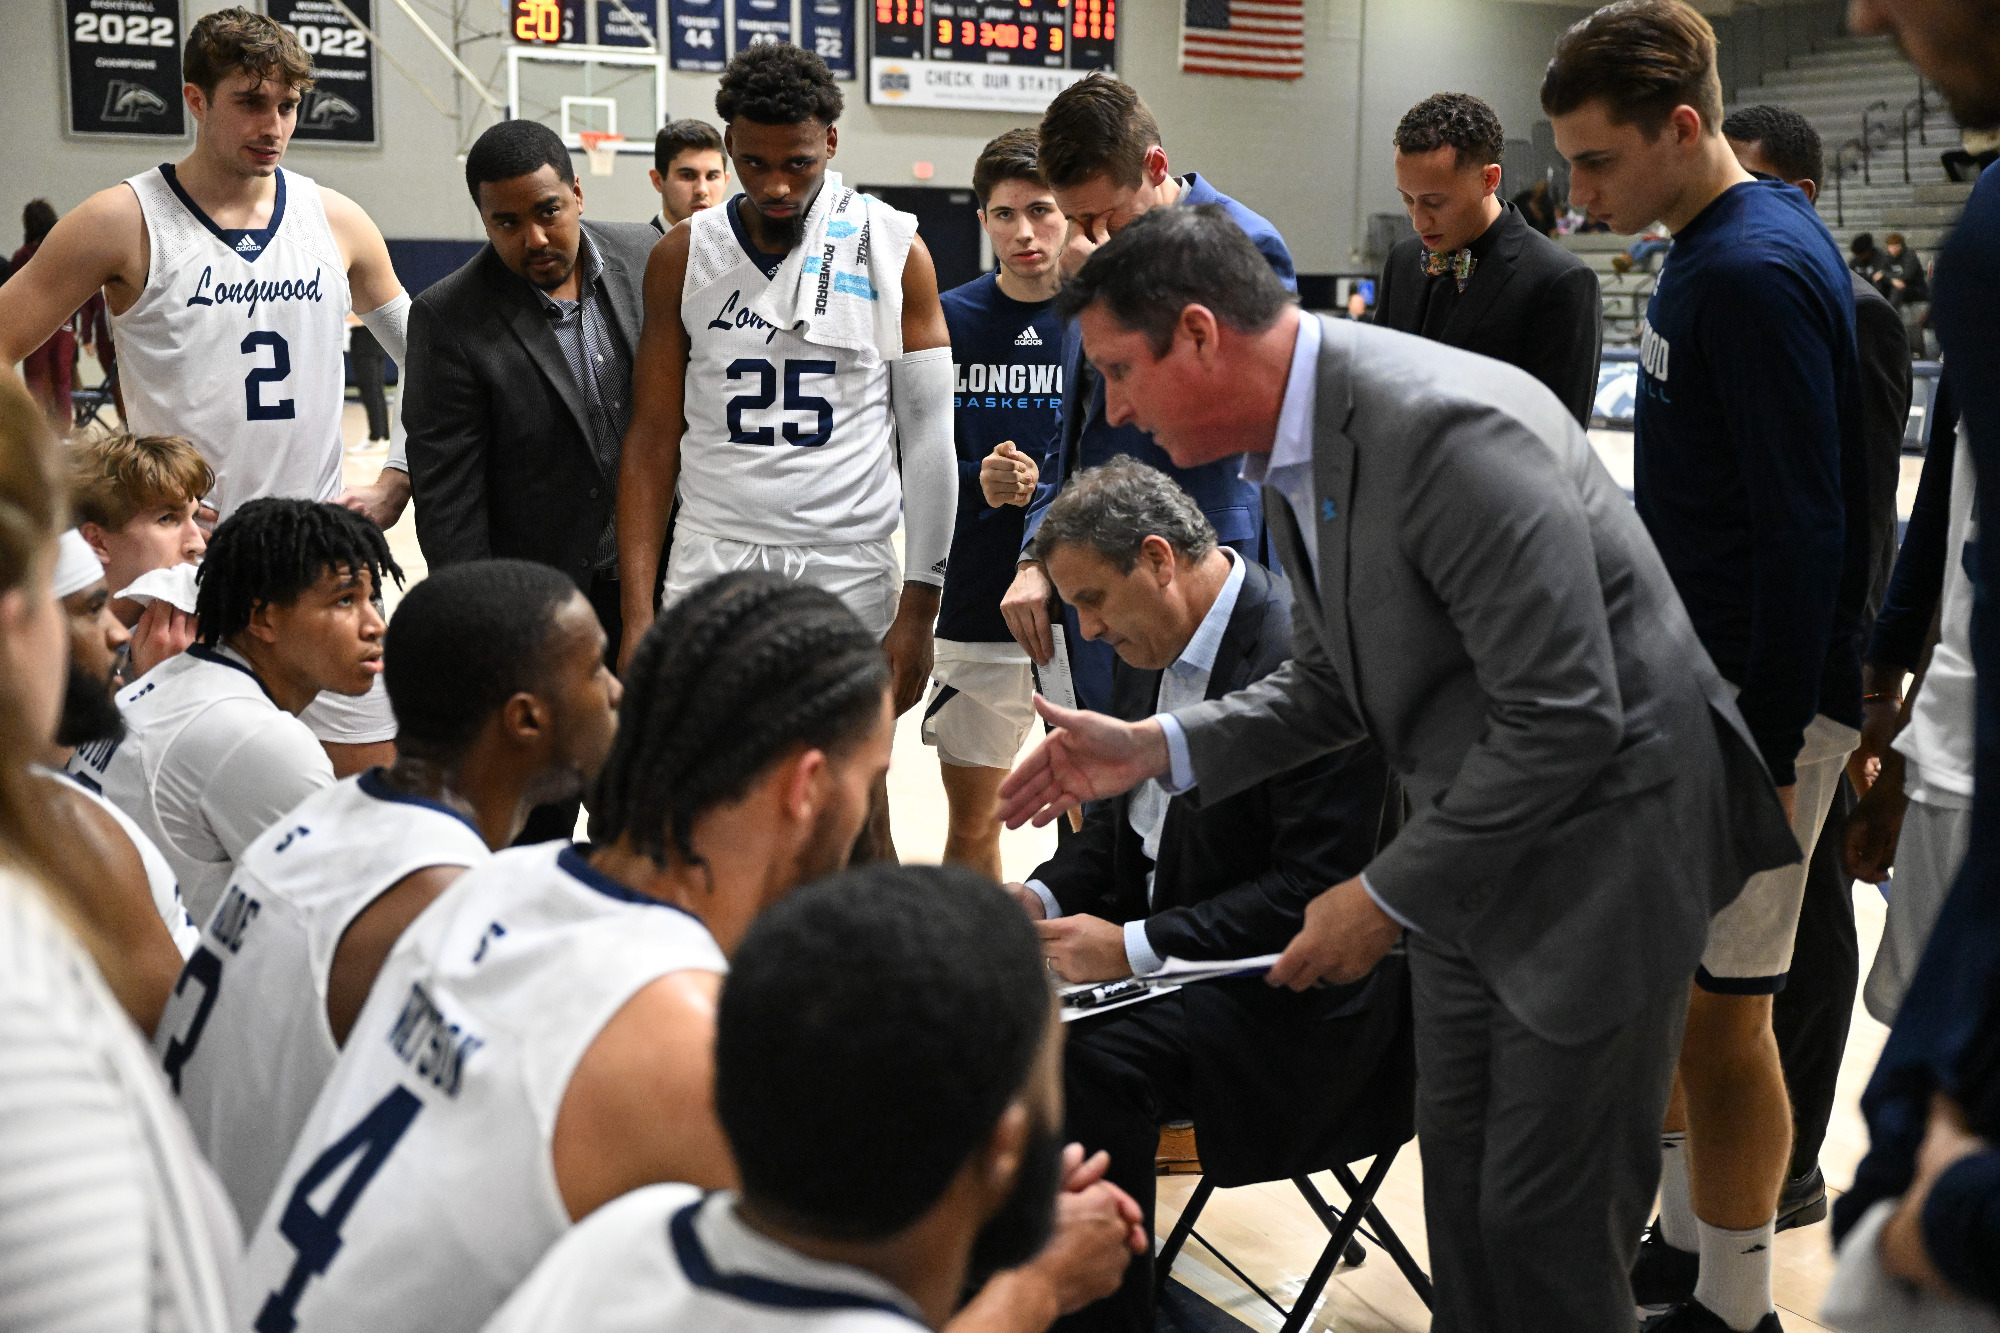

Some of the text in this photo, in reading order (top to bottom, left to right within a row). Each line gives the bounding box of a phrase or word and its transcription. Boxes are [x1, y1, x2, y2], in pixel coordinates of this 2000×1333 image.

[74, 12, 175, 47] 2022
[516, 2, 559, 41] 20
[684, 28, 714, 49] 44
[280, 23, 367, 58] 022
[815, 38, 843, 59] 22
[925, 69, 973, 88] CHECK
[982, 73, 1010, 90] OUR
[1018, 76, 1063, 92] STATS
[235, 244, 262, 252] adidas
[186, 265, 323, 319] Longwood
[814, 243, 836, 317] POWERADE
[1014, 337, 1043, 346] adidas
[241, 331, 296, 421] 2
[726, 358, 837, 447] 25
[253, 1083, 425, 1333] 4
